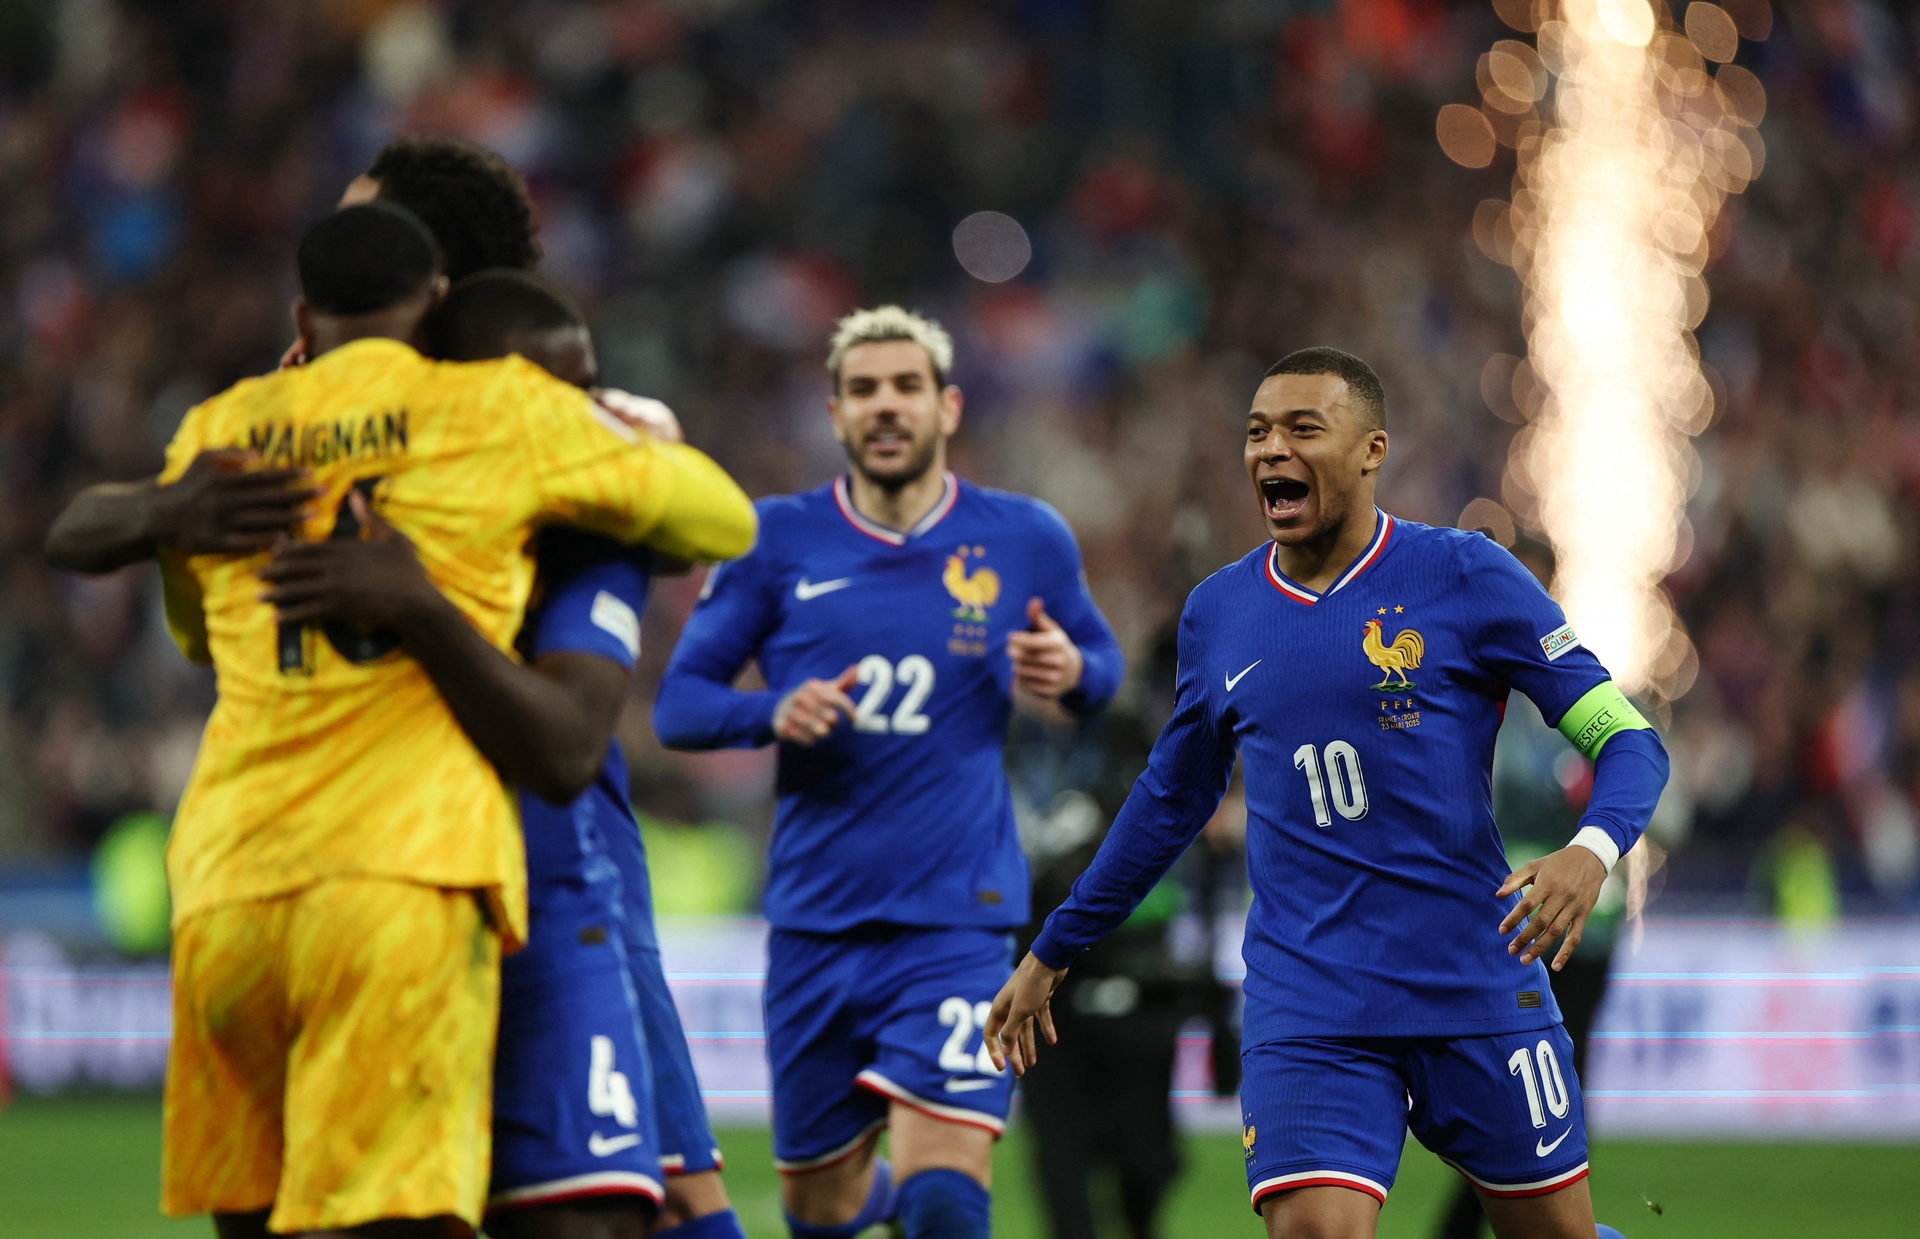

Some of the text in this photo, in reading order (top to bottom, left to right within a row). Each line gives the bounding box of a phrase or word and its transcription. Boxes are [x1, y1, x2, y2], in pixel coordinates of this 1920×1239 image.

[1541, 634, 1555, 645] UEFA
[851, 654, 936, 735] 22
[1378, 715, 1397, 723] FRANCE
[1391, 721, 1404, 729] MARS
[1405, 719, 1420, 728] 2025
[1294, 740, 1369, 827] 10
[588, 1034, 639, 1128] 4
[1508, 1040, 1569, 1129] 10
